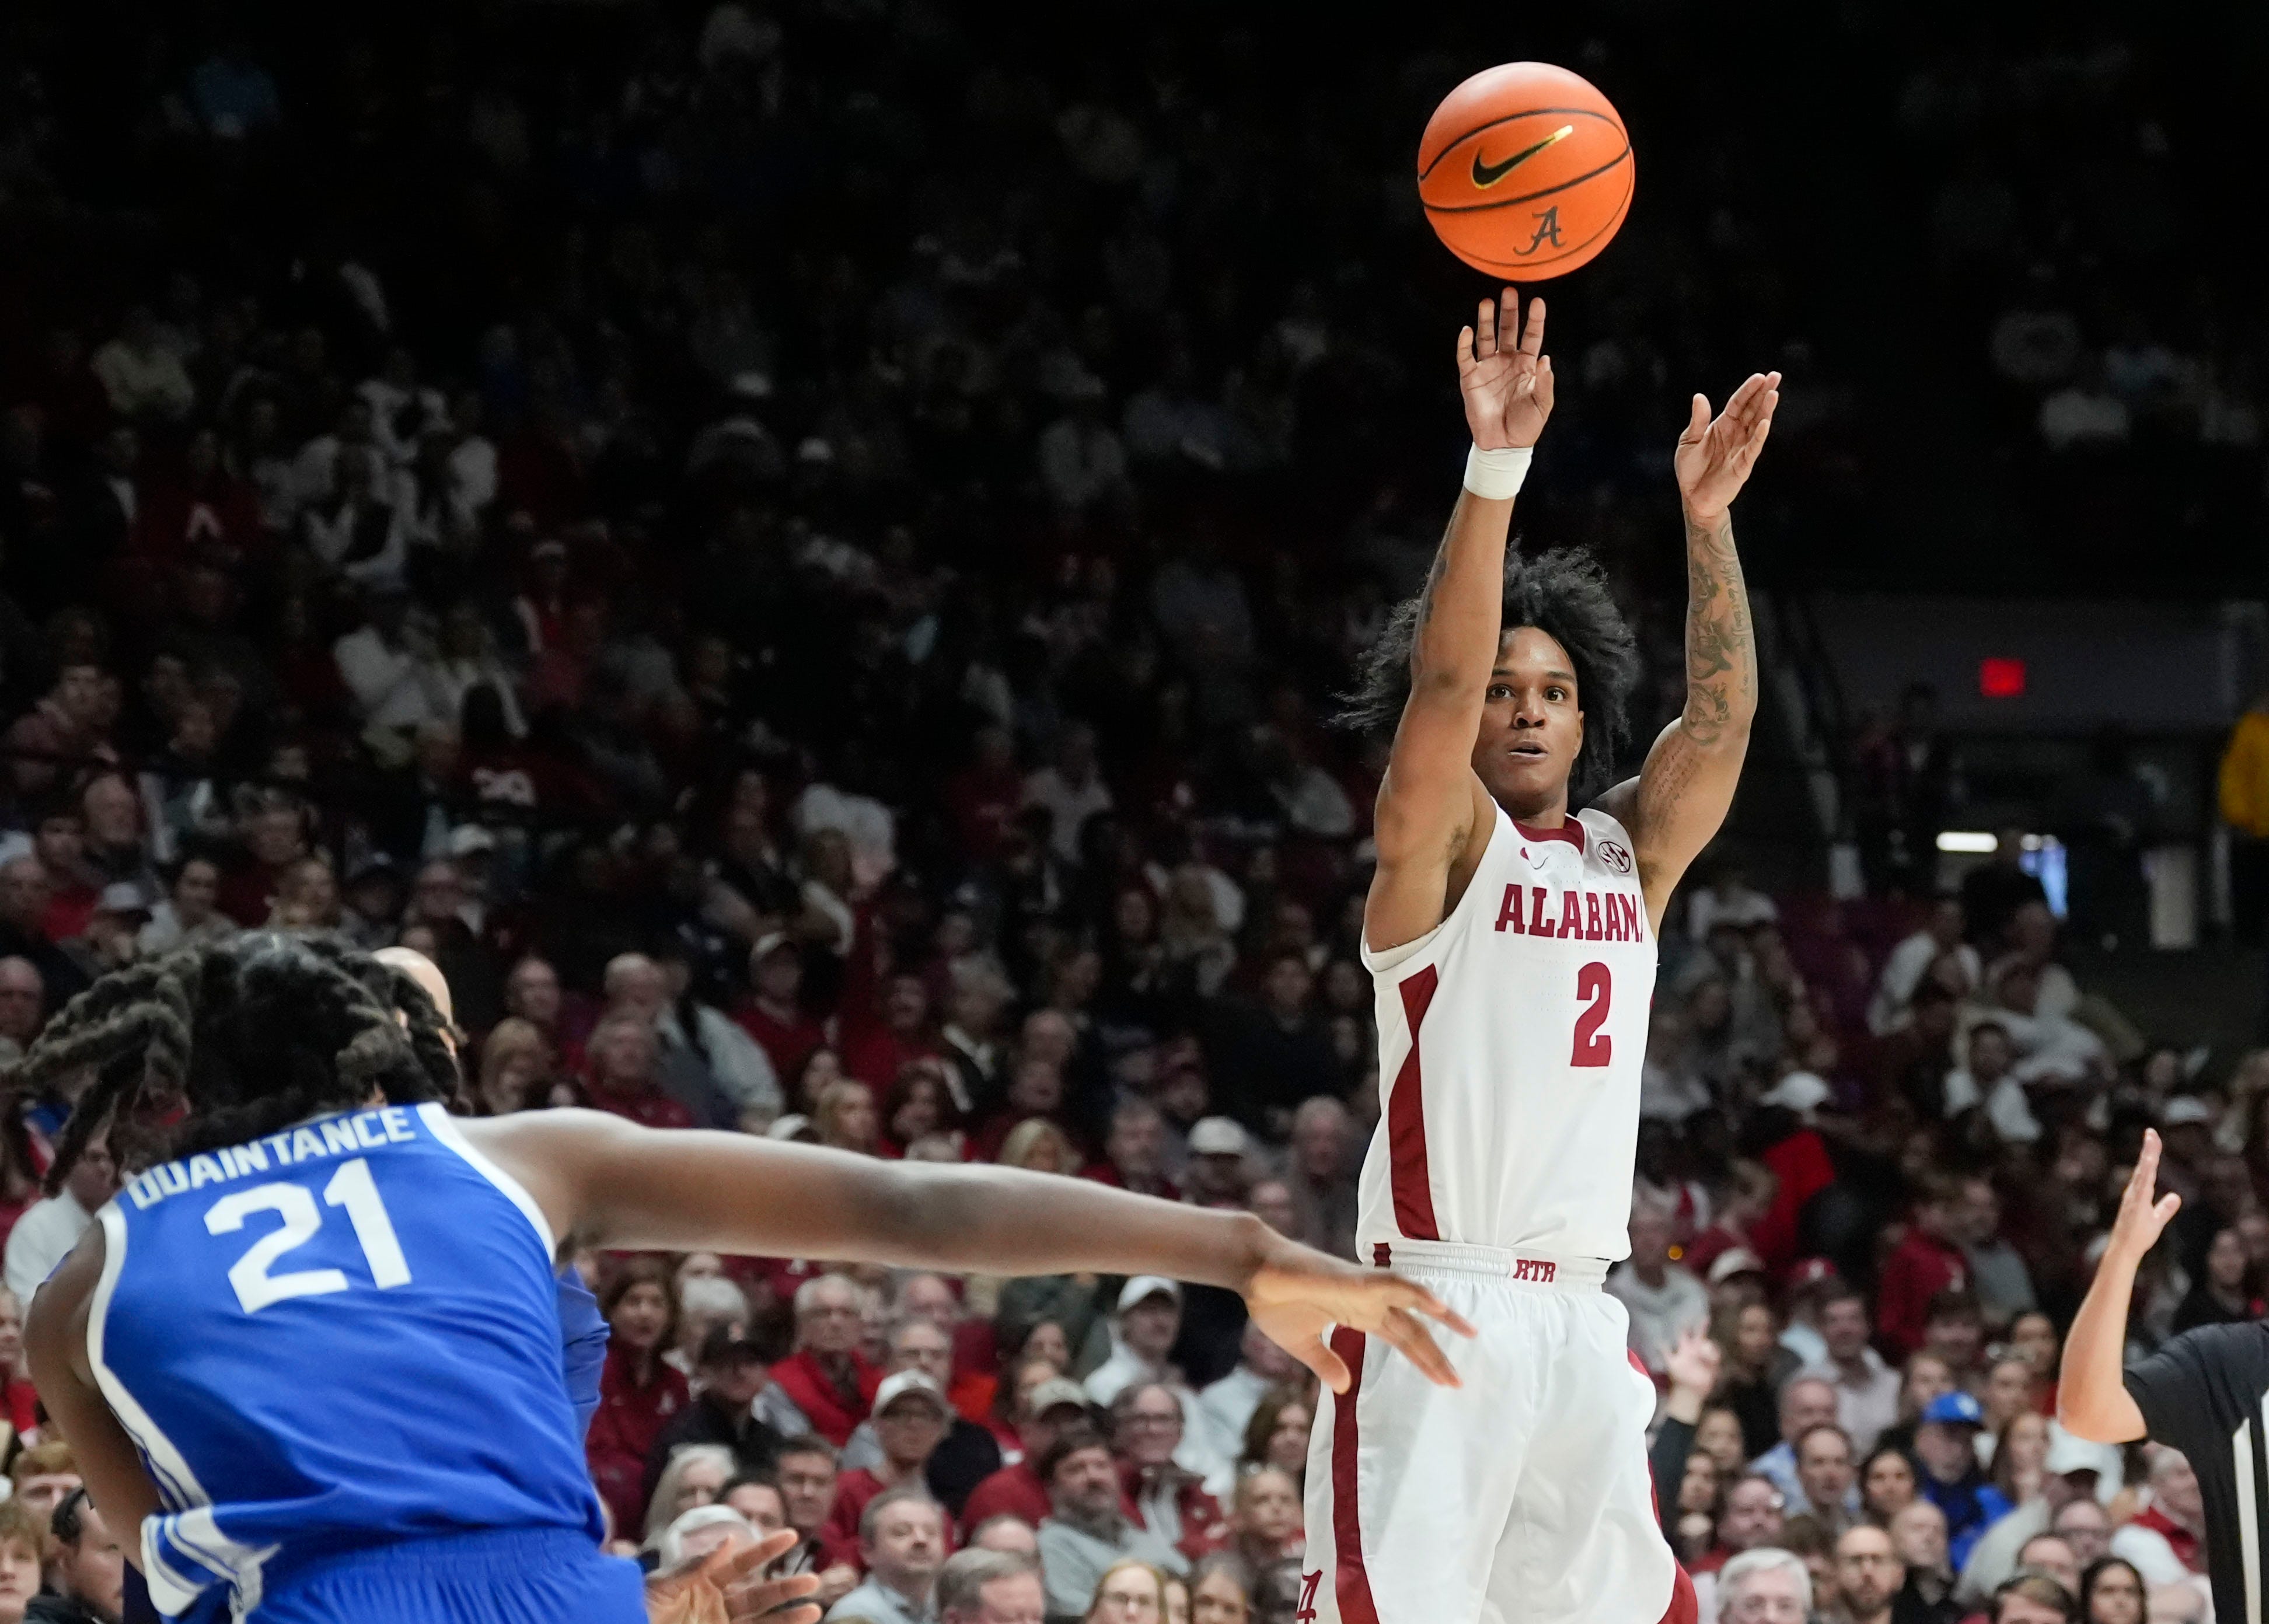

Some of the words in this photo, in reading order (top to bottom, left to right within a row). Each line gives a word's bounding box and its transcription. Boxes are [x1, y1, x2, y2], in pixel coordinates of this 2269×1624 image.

[1513, 206, 1567, 256] A
[1495, 883, 1643, 943] ALABAM
[1570, 962, 1611, 1067] 2
[203, 1157, 411, 1315] 21
[1513, 1259, 1556, 1283] RTR
